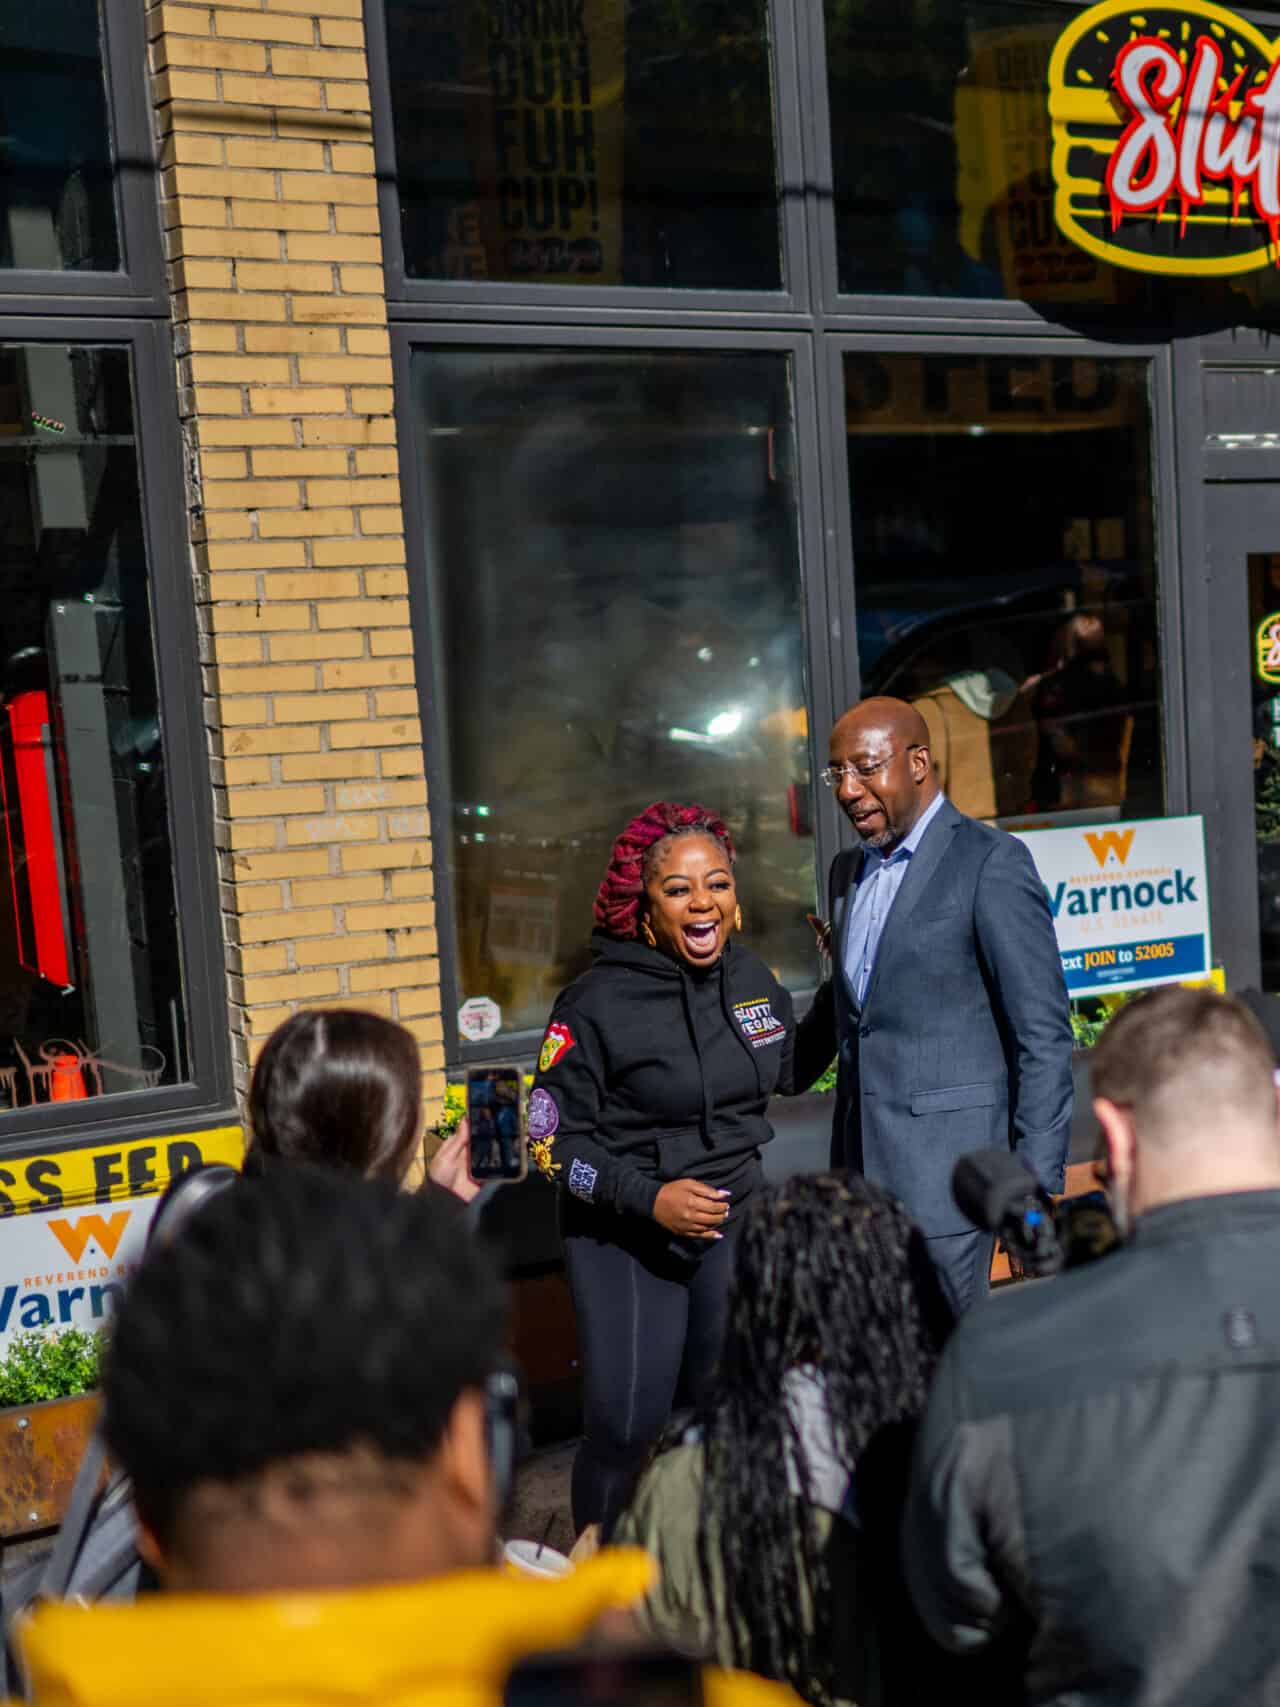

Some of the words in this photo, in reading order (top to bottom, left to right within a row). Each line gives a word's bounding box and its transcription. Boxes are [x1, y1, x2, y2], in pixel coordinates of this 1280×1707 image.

[1061, 954, 1083, 971] ext
[1084, 949, 1117, 972] JOIN
[1118, 950, 1133, 963] to
[1135, 941, 1175, 962] 52005
[23, 1265, 111, 1289] REVEREND
